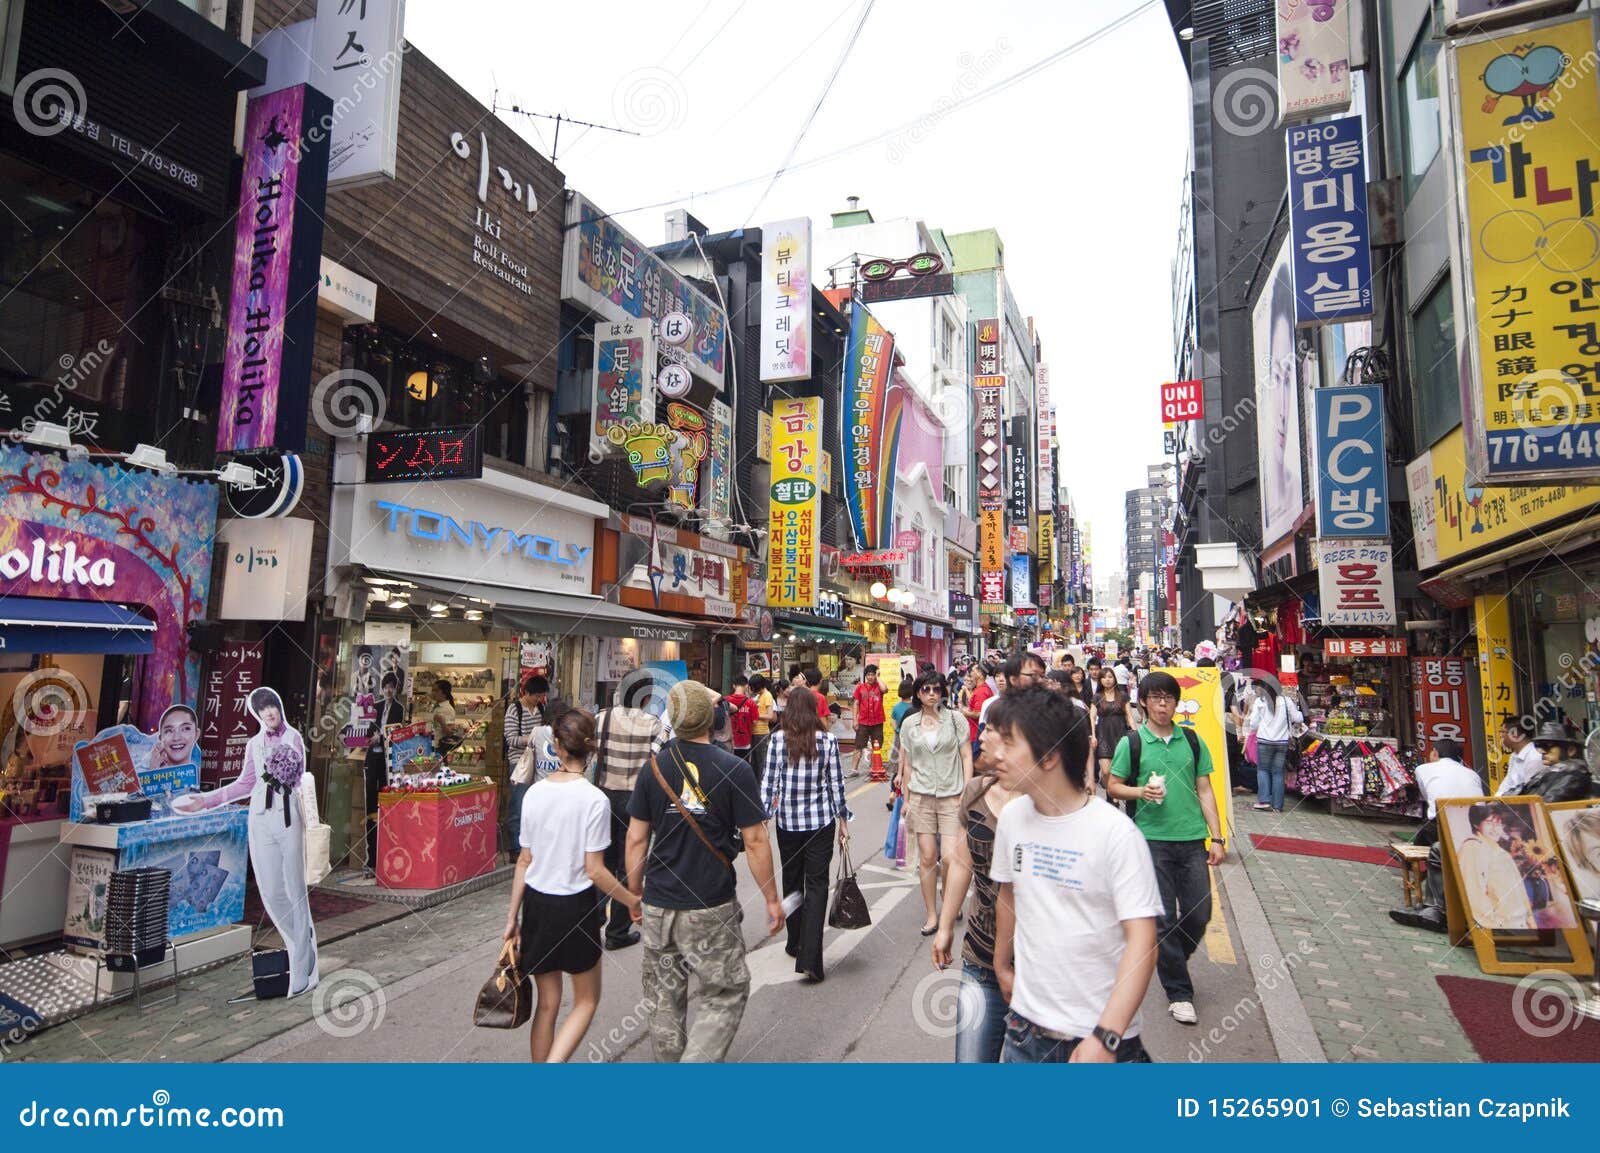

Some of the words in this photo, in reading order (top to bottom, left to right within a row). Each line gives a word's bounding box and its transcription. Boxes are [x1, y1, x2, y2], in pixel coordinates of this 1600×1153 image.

[1293, 125, 1338, 146] PRO
[1293, 140, 1361, 175] 명동
[1470, 142, 1599, 218] 가나
[249, 173, 283, 292] Holika
[475, 206, 501, 240] Iki
[474, 235, 498, 259] Roll
[501, 254, 527, 278] Food
[1301, 173, 1361, 313] 미용실
[473, 250, 533, 295] Restaurant
[775, 248, 792, 356] 뷰티크레딧
[610, 323, 634, 336] はな
[666, 320, 683, 337] は
[1491, 285, 1539, 402] カナ眼鏡院
[235, 306, 271, 427] Holika
[665, 372, 682, 387] な
[976, 376, 1002, 387] MUD
[851, 333, 883, 489] 레인보우안경원
[1164, 385, 1195, 401] UNI
[1165, 400, 1198, 418] QLO
[1551, 403, 1600, 421] 명동
[1494, 408, 1542, 425] 明洞店
[779, 402, 810, 474] 금강
[1327, 394, 1382, 530] PC방
[775, 482, 811, 501] 철판
[376, 500, 592, 567] TONYMOLY
[799, 509, 812, 568] 섞어부대
[0, 537, 116, 587] olika
[770, 510, 785, 602] 낙지불고기
[784, 510, 798, 602] 오삼불고기
[1323, 550, 1355, 564] BEER
[1359, 549, 1388, 562] PUB
[799, 572, 812, 602] 불낙
[1336, 563, 1384, 610] 호프
[813, 599, 843, 621] CREDIT
[1328, 610, 1392, 624] ビールレストラン
[630, 626, 688, 641] TONYMOLY
[1329, 640, 1387, 654] 미용실
[1425, 660, 1463, 686] 명동
[204, 671, 224, 738] 돈까스
[231, 671, 252, 738] 돈까스
